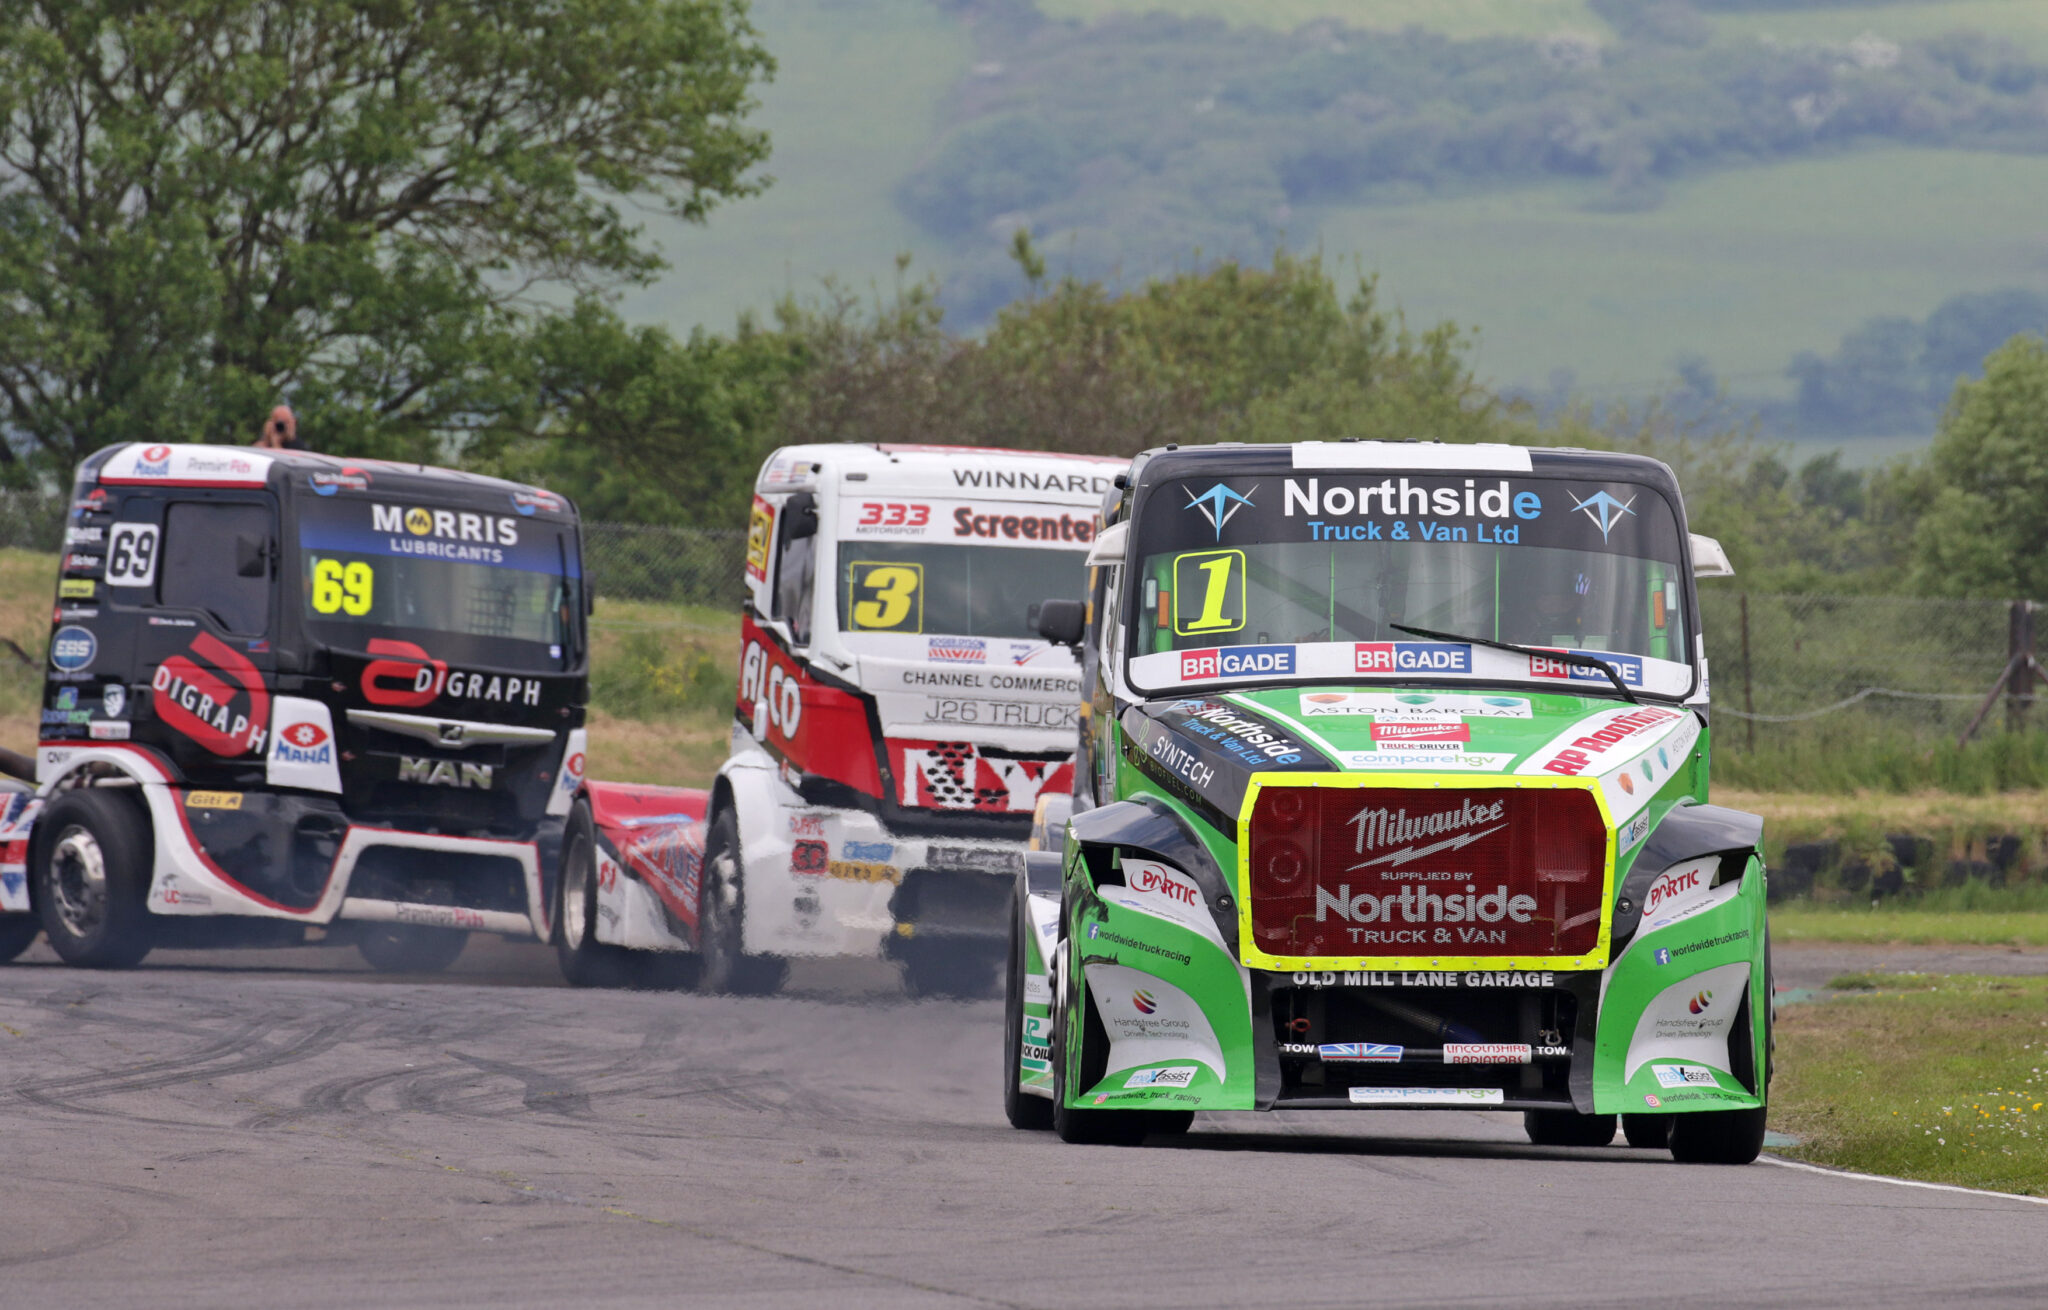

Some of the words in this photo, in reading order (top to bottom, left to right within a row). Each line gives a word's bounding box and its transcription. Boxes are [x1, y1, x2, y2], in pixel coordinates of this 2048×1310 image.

[1284, 478, 1542, 520] Northside
[371, 504, 518, 546] MORRIS
[858, 503, 930, 526] 333
[856, 526, 926, 536] MOTORSPORT
[1307, 521, 1382, 541] Truck
[1390, 520, 1410, 540] &
[1418, 521, 1468, 542] Van
[1477, 523, 1519, 544] Ltd
[109, 531, 155, 578] 69
[391, 538, 503, 564] LUBRICANTS
[312, 559, 374, 616] 69
[853, 566, 918, 628] 3
[1187, 554, 1234, 631] 1
[1182, 651, 1290, 677] BRIGADE
[1356, 645, 1465, 669] BRIGADE
[413, 668, 541, 706] DIGRAPH
[902, 670, 983, 688] CHANNEL
[152, 665, 268, 754] DIGRAPH
[925, 700, 977, 722] J26
[1308, 706, 1398, 714] ASTON
[1410, 707, 1526, 716] BARCLAY
[1181, 718, 1215, 736] Truck
[1209, 731, 1227, 741] &
[1220, 736, 1245, 752] Van
[1239, 749, 1268, 765] Ltd
[1194, 707, 1302, 765] Northside
[1374, 723, 1462, 736] Milwaukee
[1542, 749, 1592, 776] RP
[1570, 706, 1682, 754] Roofing
[275, 741, 330, 765] MAHA
[1153, 735, 1215, 788] SYNTECH
[1352, 752, 1496, 767] comparehgv
[399, 755, 493, 790] MAN
[191, 793, 223, 806] Giti
[1346, 798, 1505, 854] Milwaukee
[1143, 870, 1197, 907] PARTIC
[1380, 872, 1451, 880] SUPPLIED
[1454, 872, 1473, 880] BY
[1651, 869, 1699, 907] PARTIC
[1316, 884, 1538, 923] Northside
[1347, 927, 1427, 944] TRUCK
[1433, 927, 1452, 944] &
[1293, 971, 1336, 988] OLD
[1344, 971, 1394, 987] MILL
[1402, 972, 1457, 987] LANE
[1465, 972, 1554, 988] GARAGE
[1161, 1018, 1190, 1029] Group
[1034, 1047, 1050, 1060] OIL
[1284, 1044, 1315, 1053] TOW
[1536, 1046, 1567, 1056] TOW
